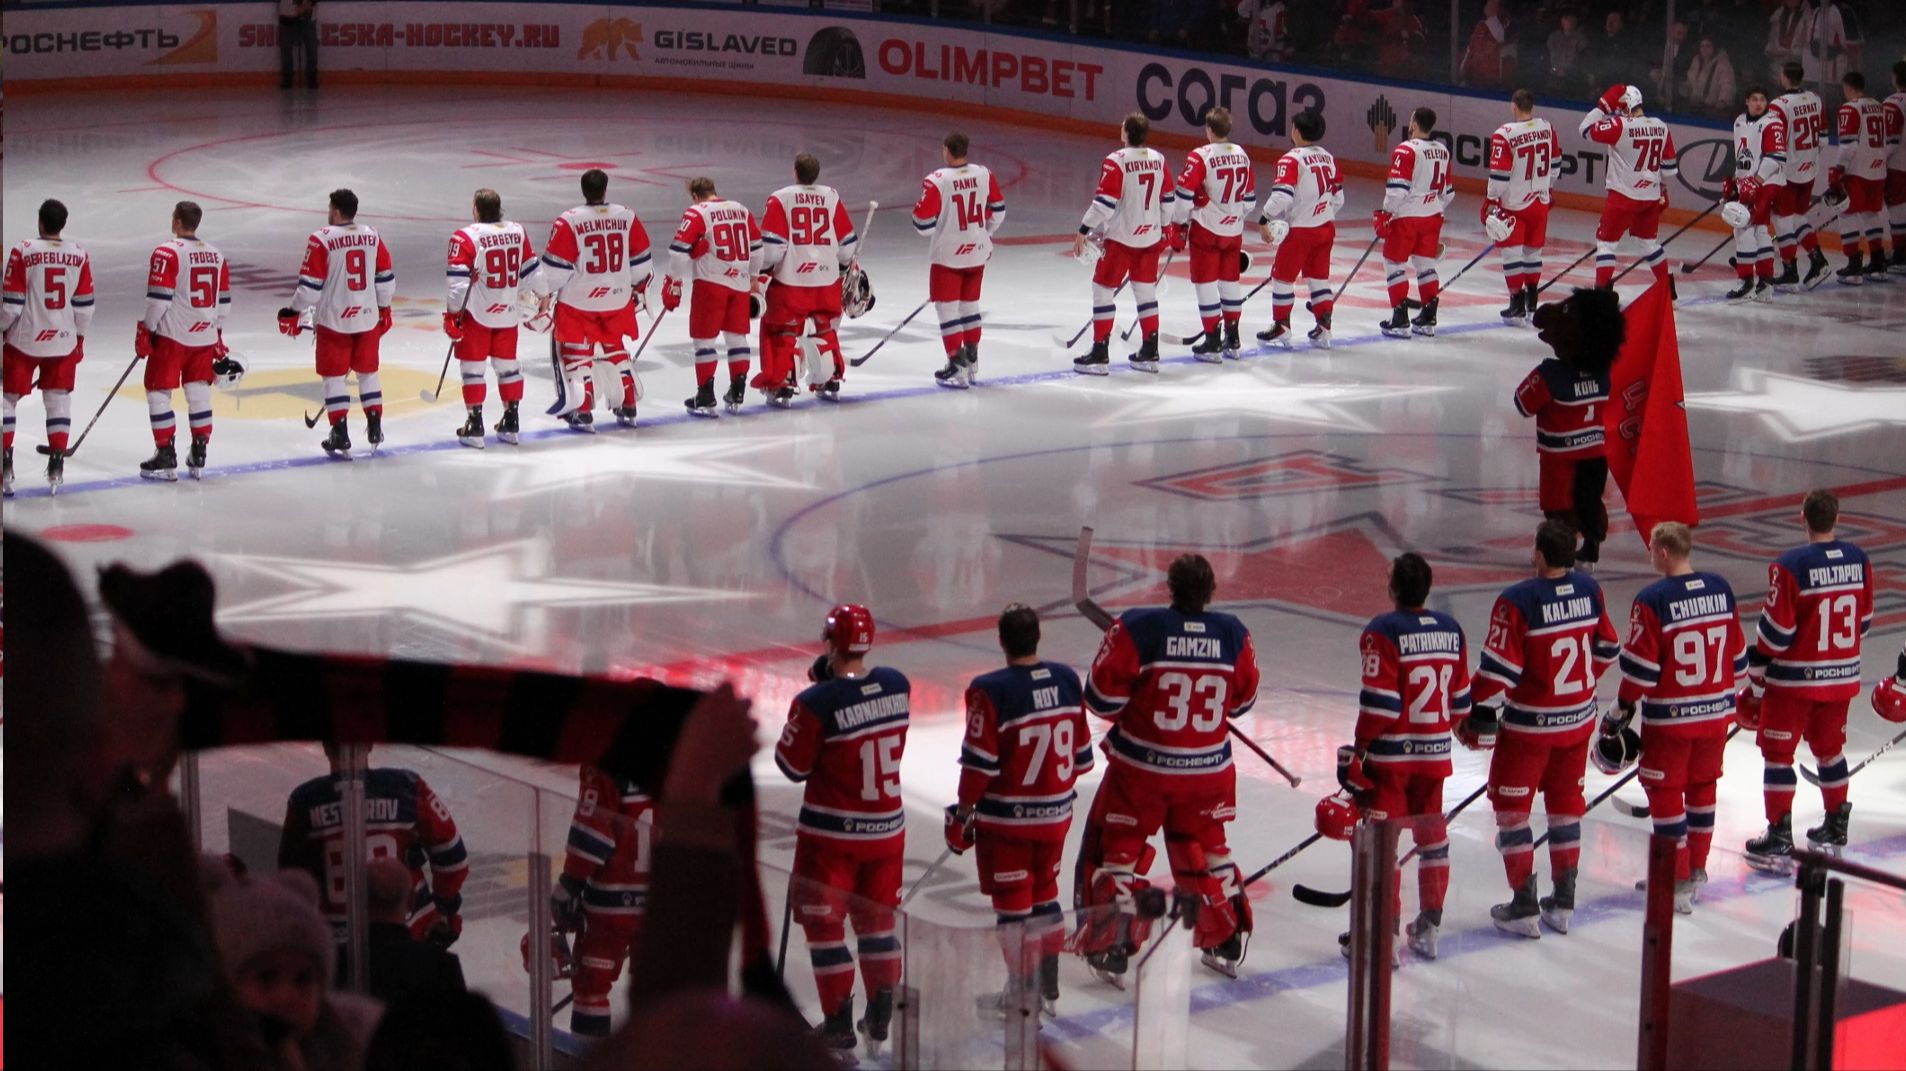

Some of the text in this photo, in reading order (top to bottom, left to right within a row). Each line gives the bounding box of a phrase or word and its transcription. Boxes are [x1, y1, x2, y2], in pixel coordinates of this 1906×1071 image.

[239, 23, 560, 48] SHCSKA-HOCKEY.RU
[654, 30, 797, 56] GISLAVED
[878, 38, 1103, 100] OLIMPBET
[1629, 127, 1665, 138] SHALUNOV
[1793, 115, 1820, 151] 28
[1517, 142, 1550, 181] 73
[1633, 140, 1663, 171] 78
[953, 177, 978, 191] PANIK
[1138, 173, 1155, 210] 7
[1216, 167, 1248, 204] 72
[1430, 161, 1445, 193] 4
[710, 209, 747, 222] POLUNIN
[795, 193, 826, 206] ISAYEV
[952, 191, 984, 231] 14
[480, 233, 521, 249] SERGEYEV
[575, 219, 628, 235] MELNICHUK
[713, 222, 749, 261] 90
[791, 207, 831, 245] 92
[189, 252, 219, 264] FROESE
[346, 249, 367, 291] 9
[485, 247, 521, 289] 99
[584, 233, 624, 274] 38
[44, 267, 66, 310] 5
[190, 266, 219, 308] 51
[1809, 562, 1863, 587] POLTAPOV
[1542, 596, 1592, 624] KALININ
[1669, 593, 1728, 621] CHURKIN
[1817, 594, 1857, 652] 13
[1166, 636, 1221, 659] GAMZIN
[1399, 631, 1460, 655] PATRIKHIYE
[1673, 624, 1728, 688] 97
[1551, 632, 1596, 696] 21
[834, 692, 909, 731] KARNAUKHO
[1032, 685, 1059, 710] ROY
[1153, 671, 1228, 733] 33
[1408, 664, 1453, 724] 28
[860, 733, 900, 800] 15
[1019, 718, 1074, 786] 79
[309, 798, 399, 829] NESTROV
